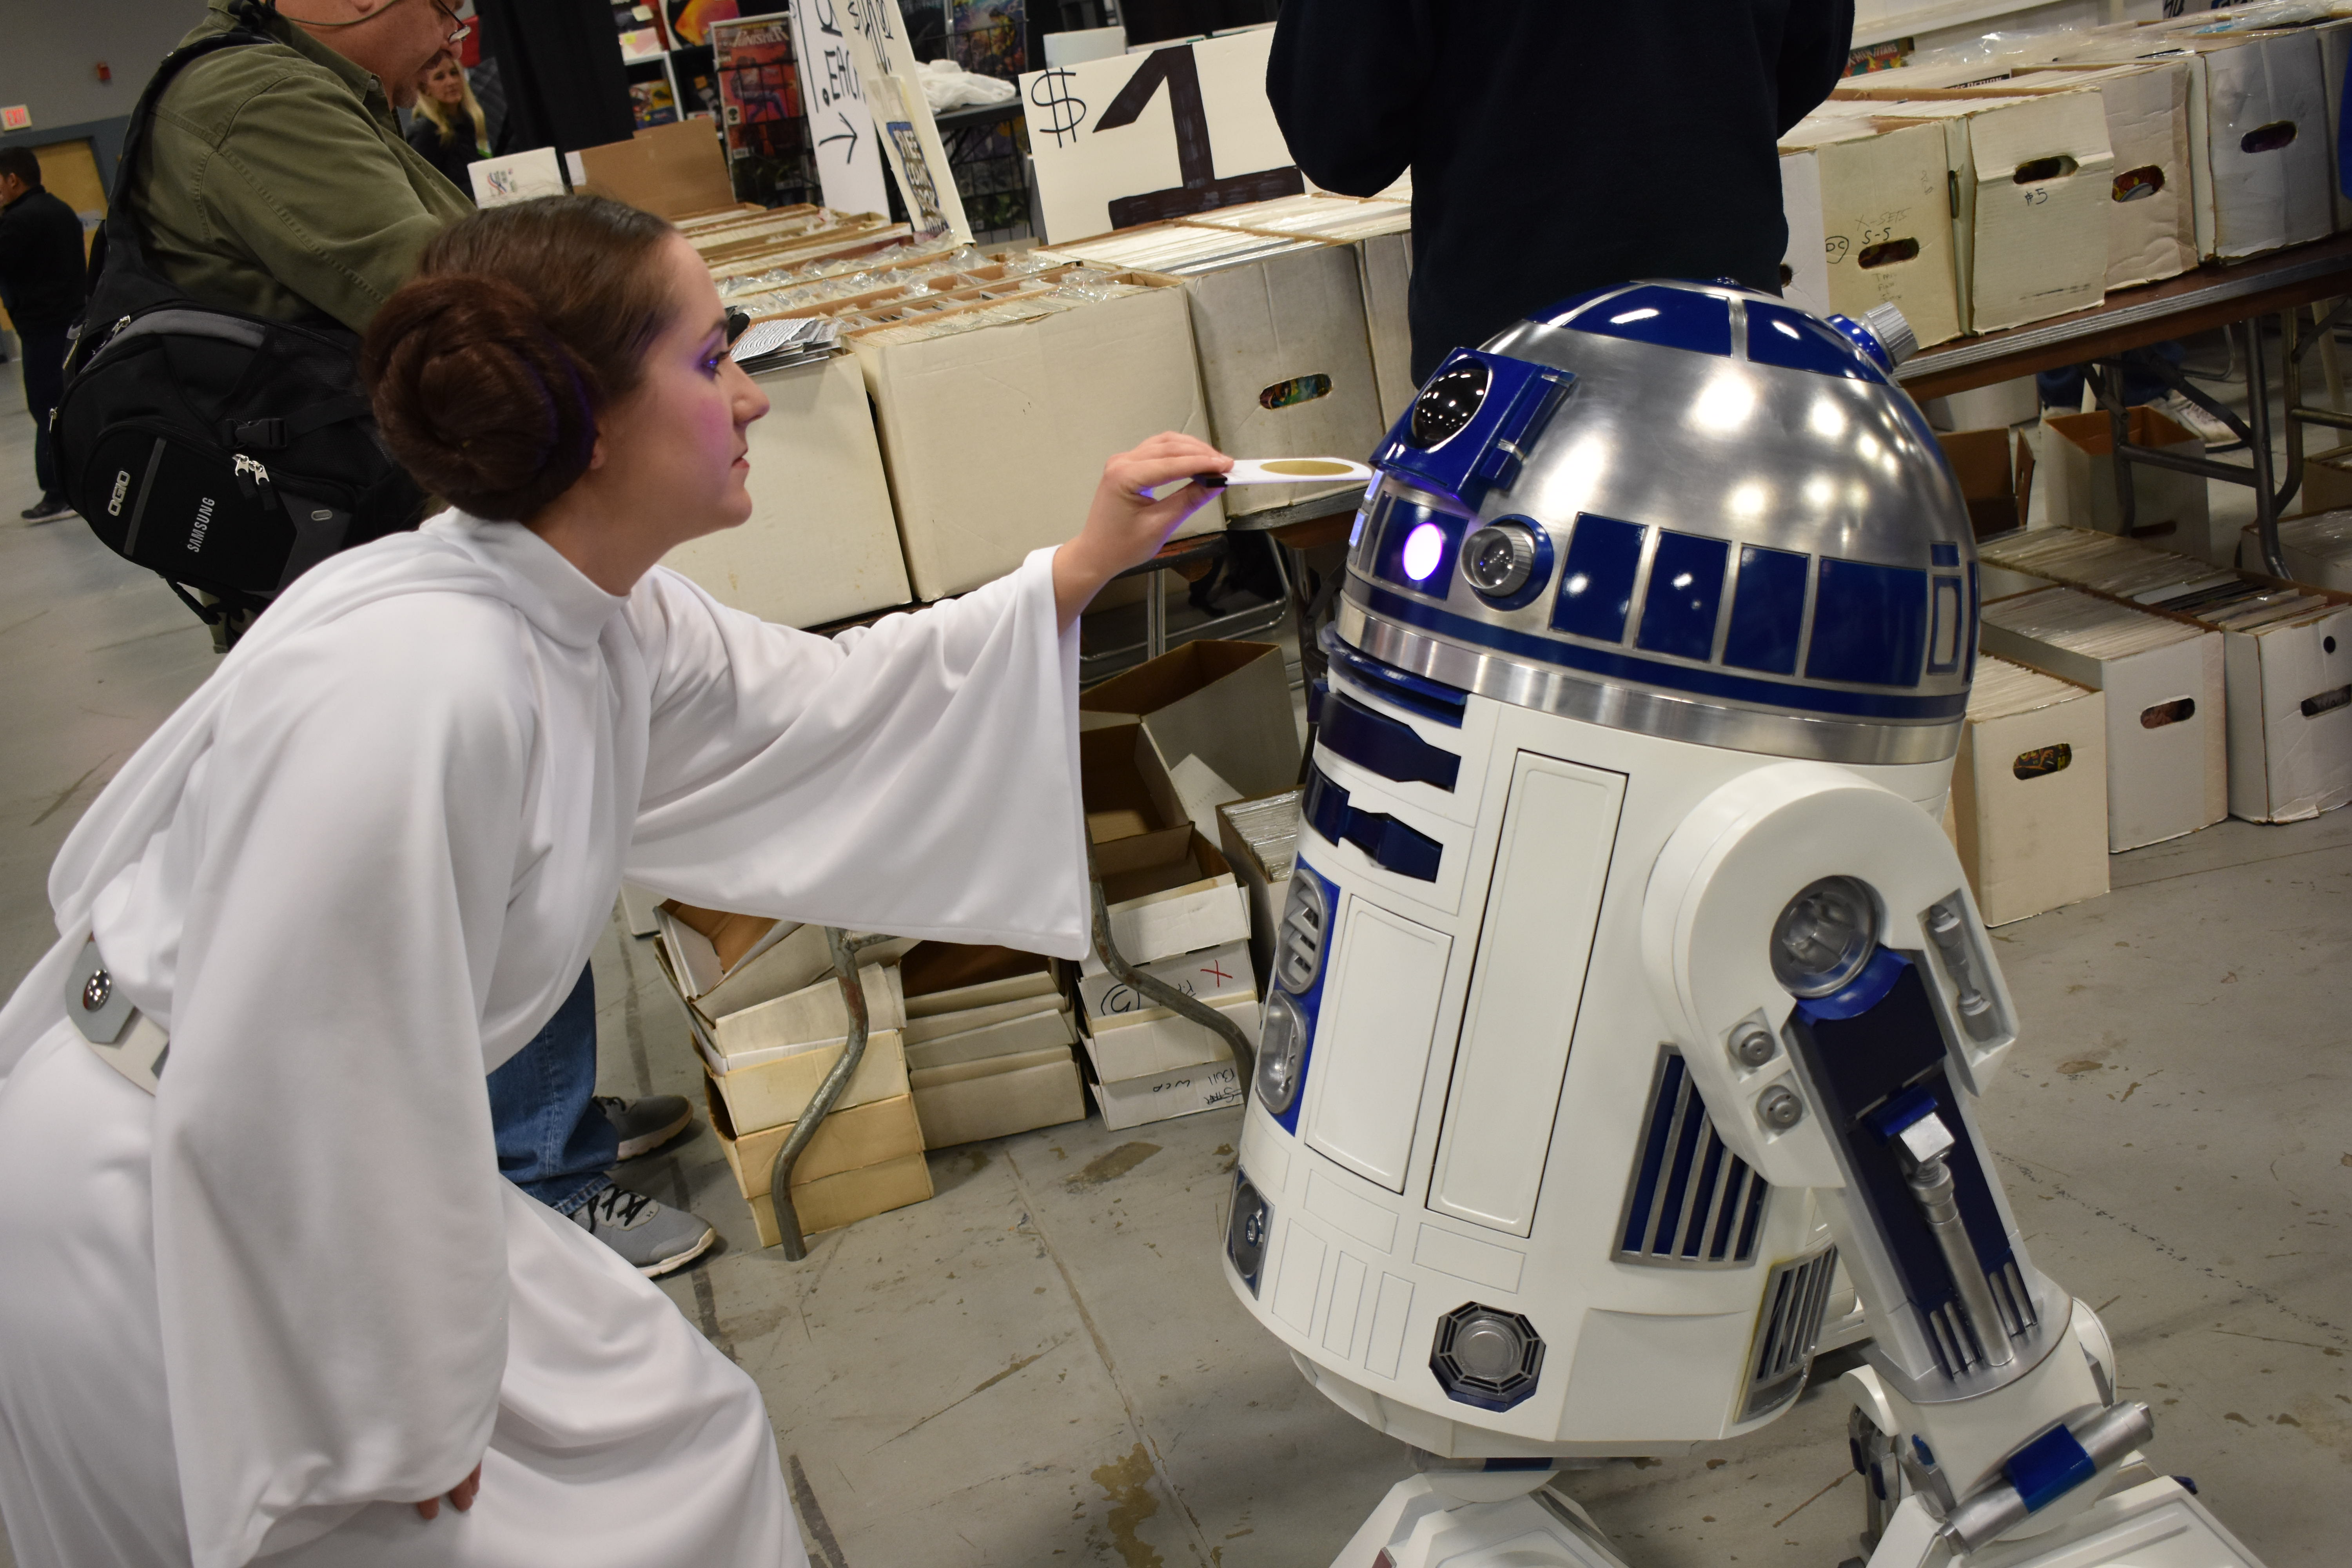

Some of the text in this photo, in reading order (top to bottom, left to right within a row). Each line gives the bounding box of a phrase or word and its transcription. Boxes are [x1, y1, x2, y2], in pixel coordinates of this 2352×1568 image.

[5, 108, 27, 127] EXIT
[2024, 188, 2048, 206] $5
[108, 470, 131, 516] OGIO
[187, 497, 215, 553] SAMSUNG
